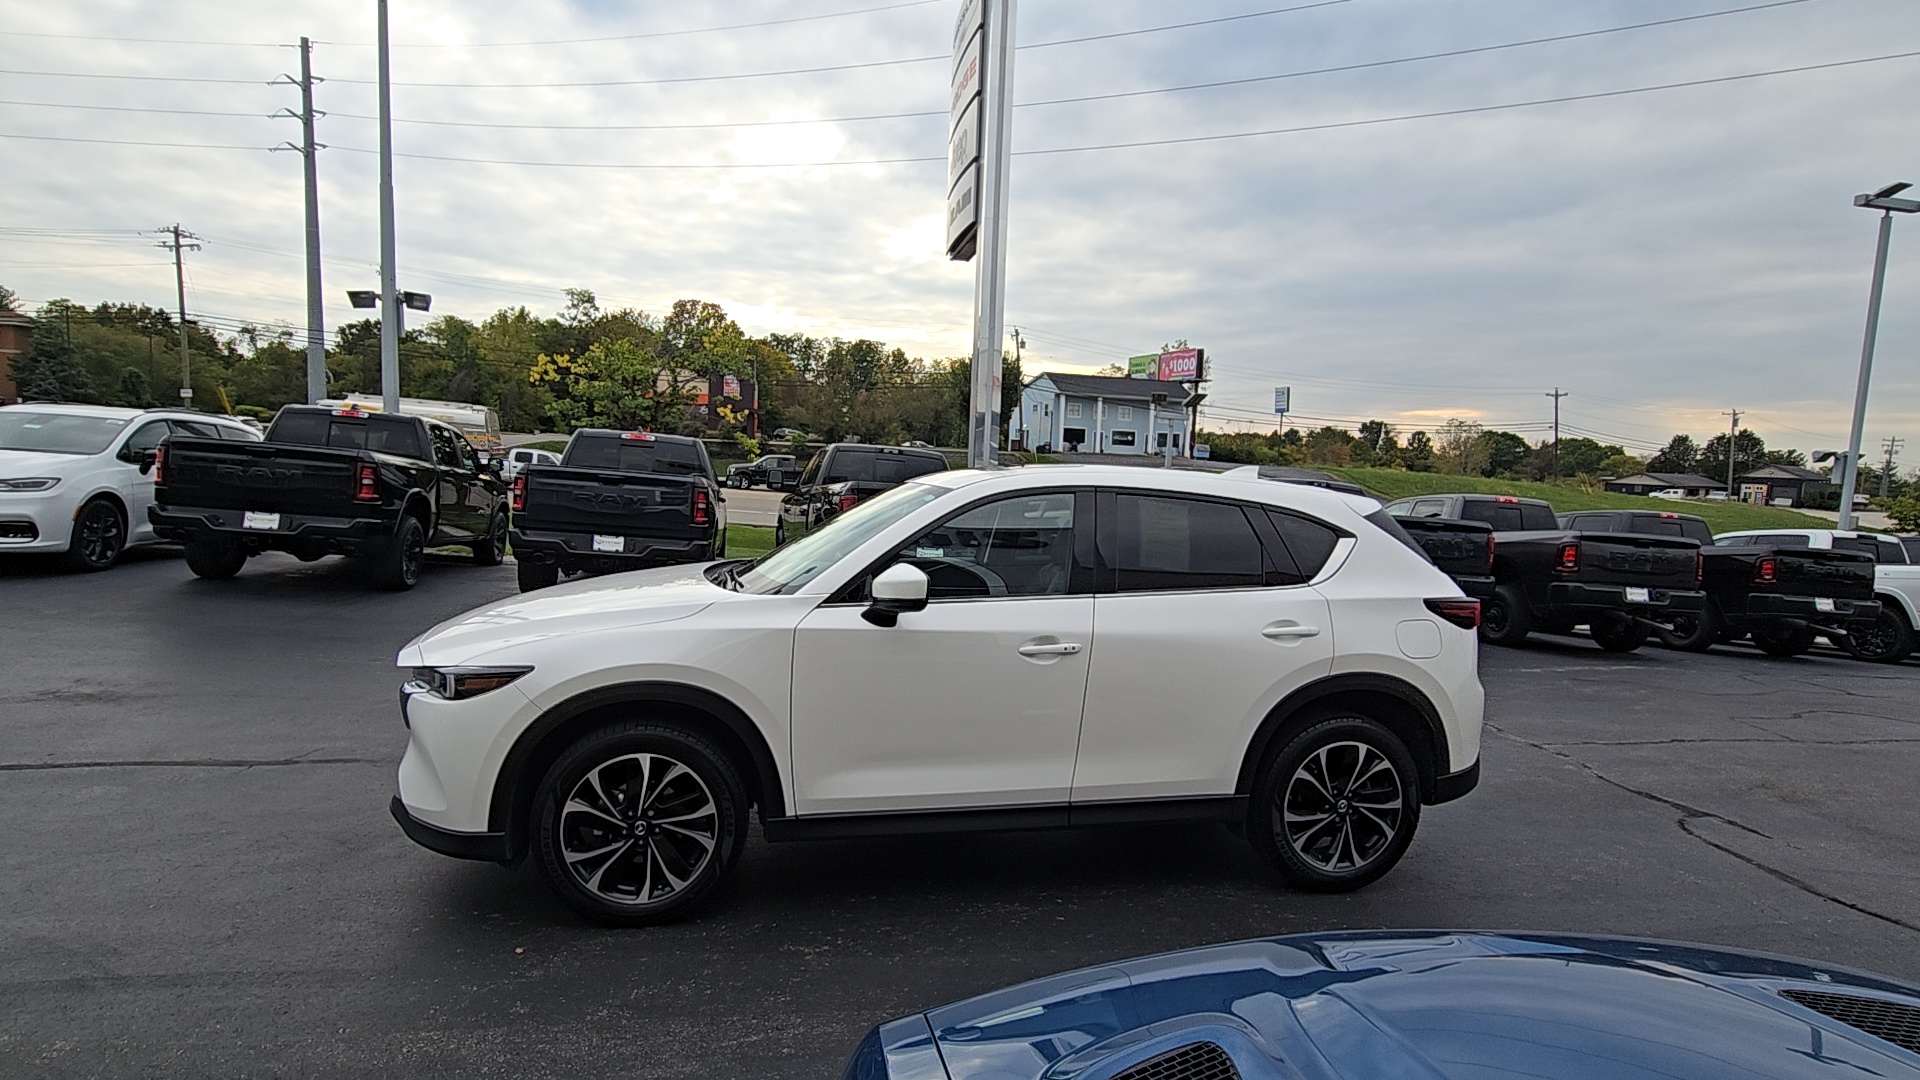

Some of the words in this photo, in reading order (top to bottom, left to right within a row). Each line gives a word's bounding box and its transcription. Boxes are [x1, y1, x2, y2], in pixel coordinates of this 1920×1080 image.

[1170, 357, 1196, 372] $1000
[216, 464, 303, 485] RAM
[573, 490, 647, 510] RAM
